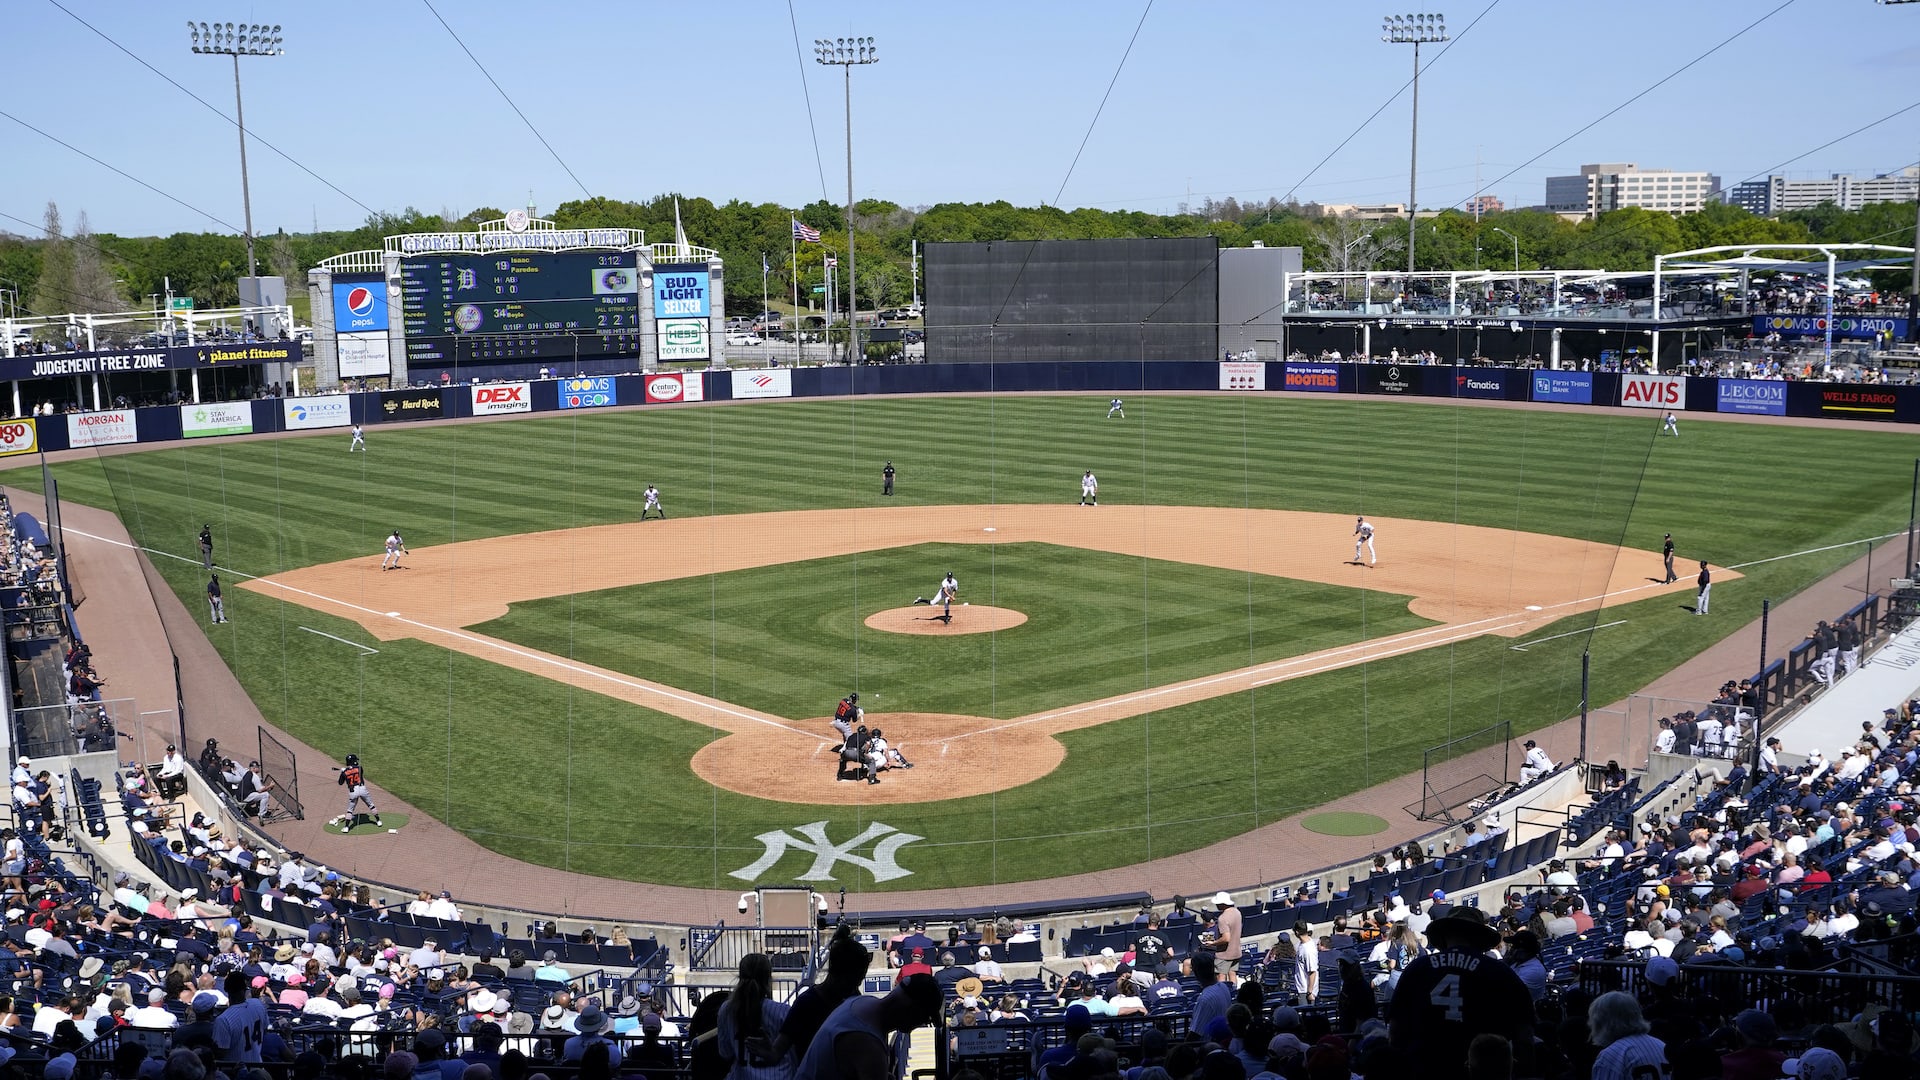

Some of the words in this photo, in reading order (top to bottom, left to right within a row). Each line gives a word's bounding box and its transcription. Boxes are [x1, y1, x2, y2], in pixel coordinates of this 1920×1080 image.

[404, 236, 461, 251] GEORGE
[464, 236, 480, 250] M.
[483, 232, 587, 249] STEINBRENNER
[589, 232, 630, 246] FIELD
[496, 261, 510, 270] 19
[599, 256, 622, 265] 3:12
[665, 277, 697, 289] BUD
[660, 288, 704, 300] LIGHT
[494, 308, 508, 318] 34
[352, 318, 373, 328] pepsi
[598, 315, 607, 326] 2
[613, 315, 623, 326] 2
[1477, 319, 1505, 327] CABANAS
[1765, 317, 1810, 329] ROOMS
[1861, 319, 1895, 332] PATIO
[669, 329, 698, 339] HESS
[209, 350, 248, 364] planet
[249, 348, 288, 360] fitness
[408, 352, 443, 360] YANKEES
[661, 347, 677, 355] TOY
[680, 346, 706, 354] TRUCK
[32, 358, 97, 376] JUDGEMENT
[100, 355, 131, 371] FREE
[133, 353, 166, 369] ZONE
[1286, 366, 1297, 374] Step
[564, 377, 610, 392] ROOMS
[1285, 374, 1337, 387] HOOTERS
[1467, 379, 1500, 390] Fanatics
[1552, 379, 1570, 387] FIFTH
[652, 383, 678, 393] Century
[1624, 381, 1680, 404] AVIS
[476, 386, 523, 404] DEX
[565, 395, 581, 408] TO
[583, 394, 604, 407] GO
[1823, 391, 1858, 402] WELLS
[1860, 393, 1896, 404] FARGO
[307, 404, 342, 412] TECO
[402, 398, 421, 410] Hard
[422, 397, 440, 410] Rock
[487, 401, 529, 410] imaging
[78, 414, 124, 427] MORGAN
[210, 415, 242, 424] AMERICA
[1430, 952, 1481, 971] GEHRIG
[1430, 973, 1464, 1022] 4
[243, 1019, 263, 1052] 14
